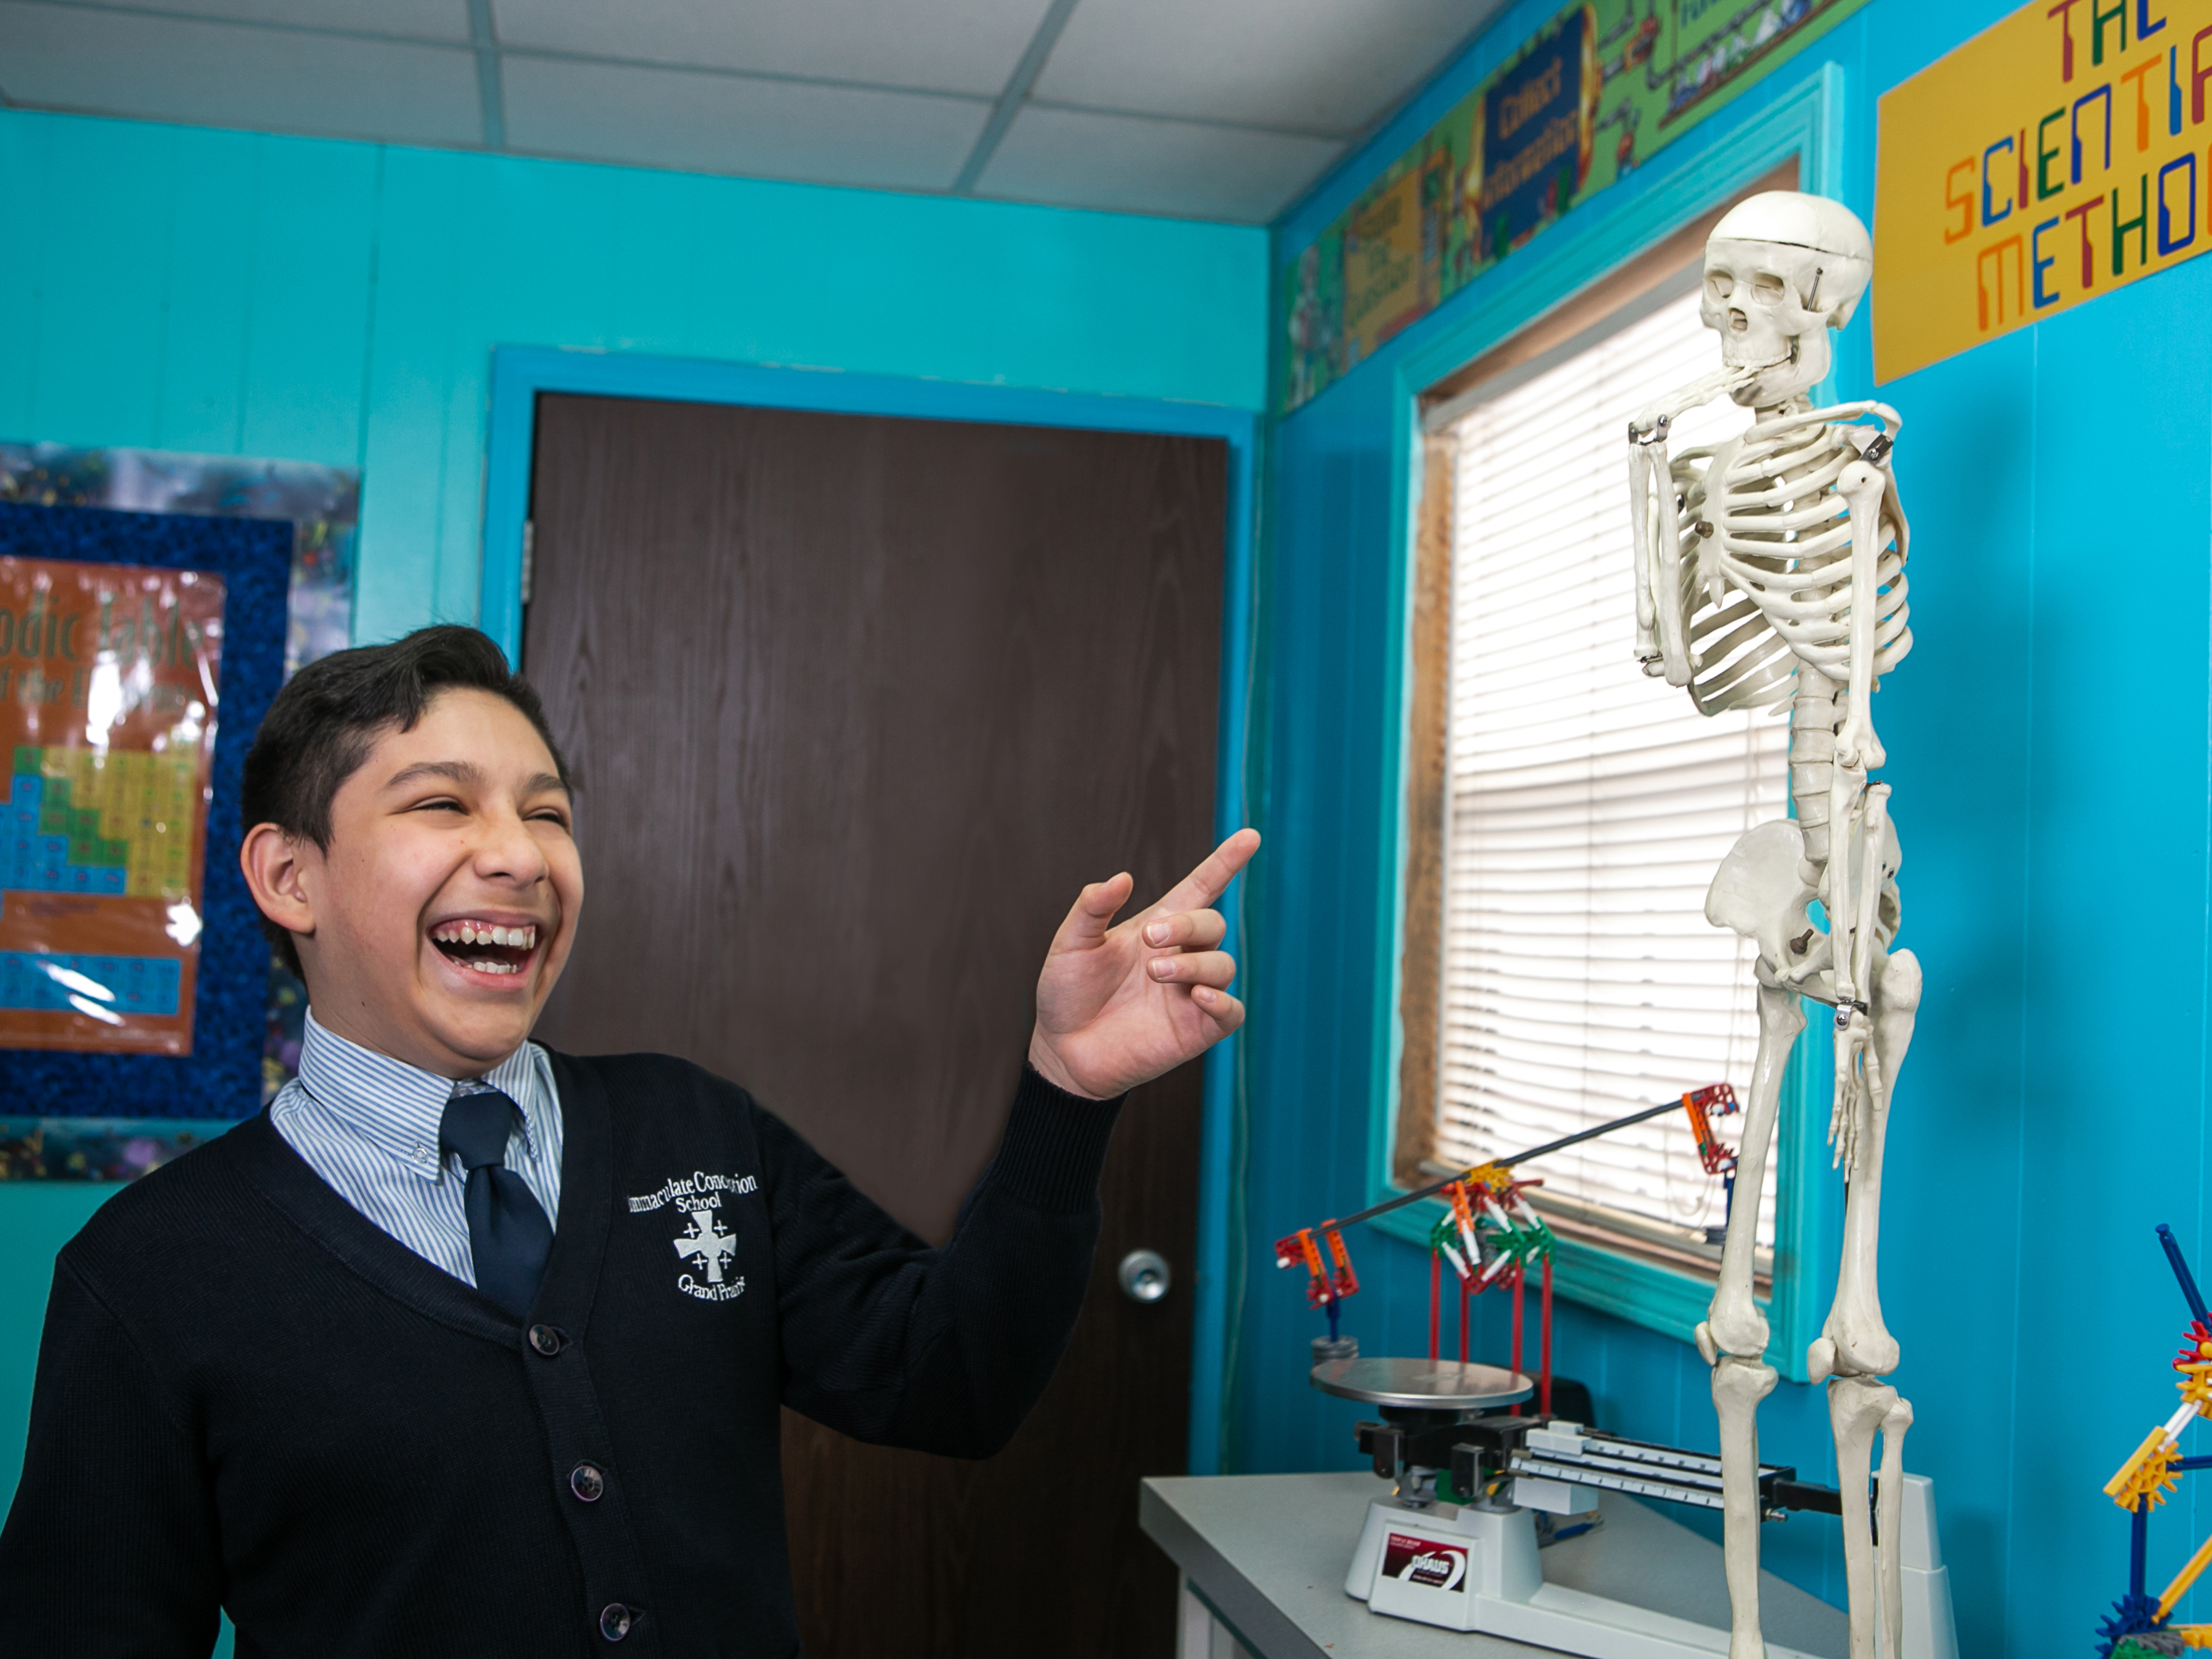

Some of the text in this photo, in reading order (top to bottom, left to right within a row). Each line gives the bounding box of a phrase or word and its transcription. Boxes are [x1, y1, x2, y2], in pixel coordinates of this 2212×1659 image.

[1977, 145, 2212, 332] METHO
[628, 1171, 758, 1213] Immaculate Concion
[675, 1191, 722, 1214] School
[678, 1274, 718, 1301] Grand
[1412, 1555, 1450, 1575] OHAUS
